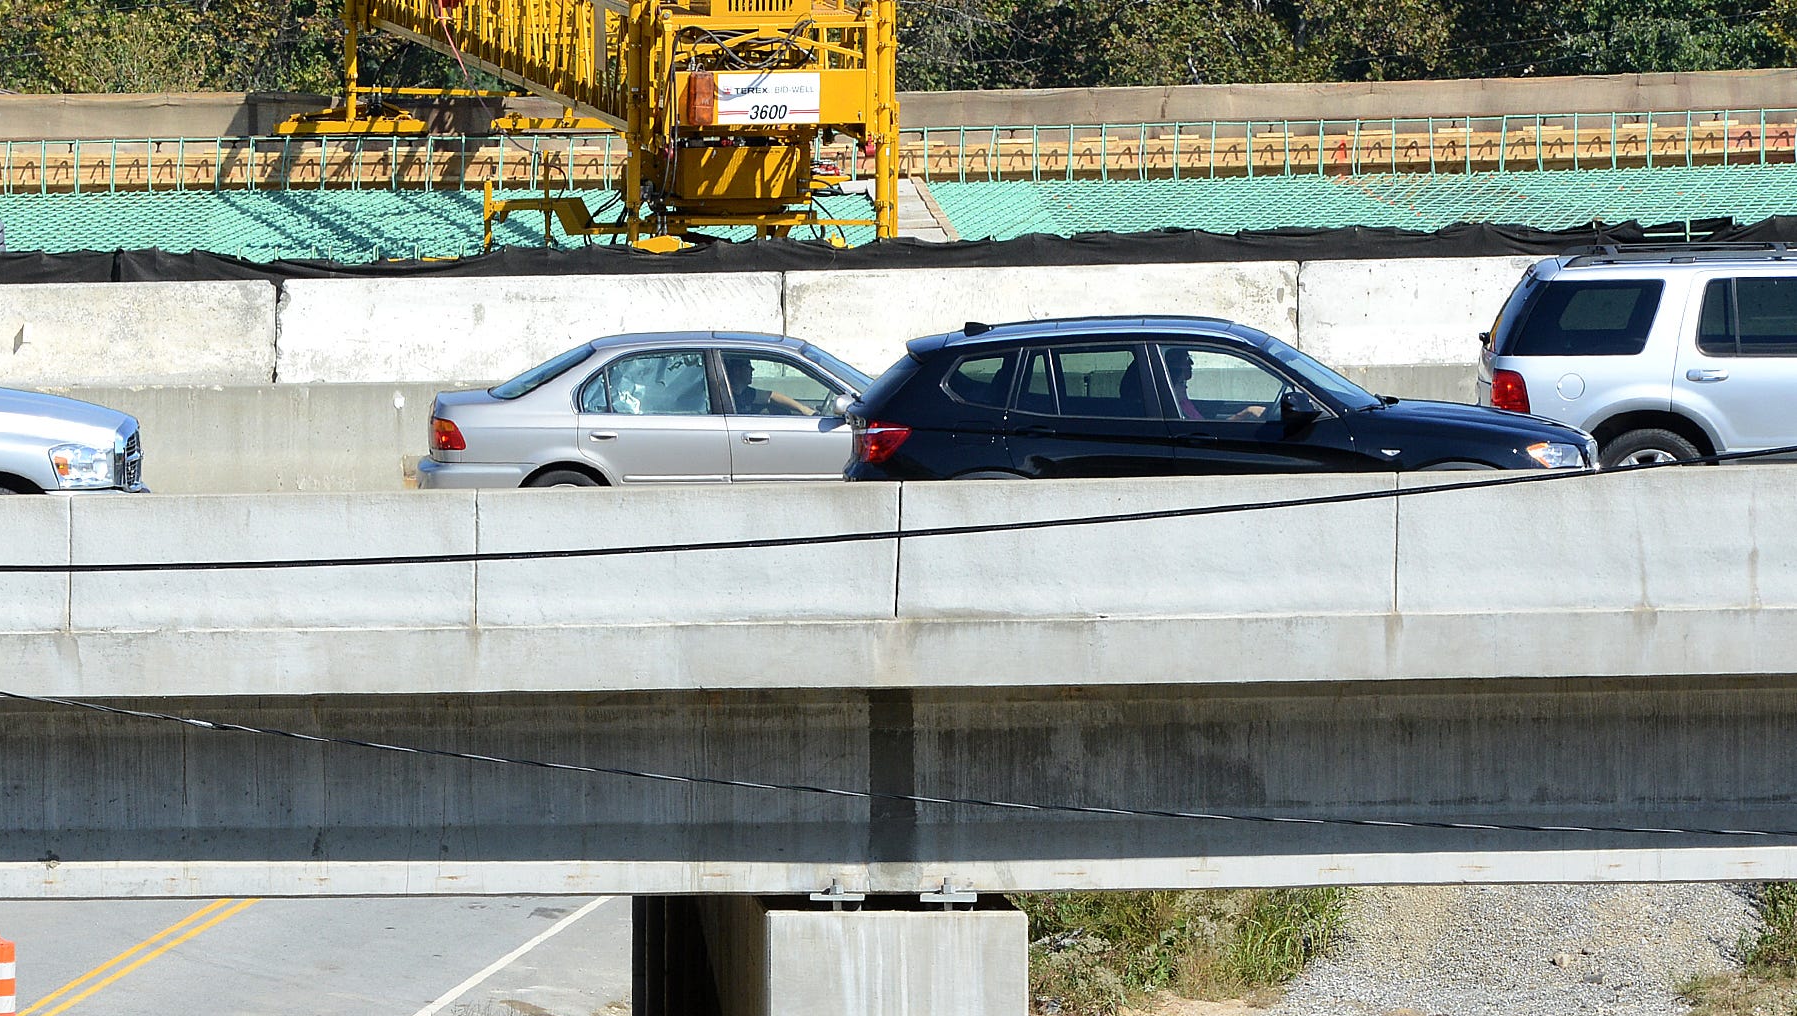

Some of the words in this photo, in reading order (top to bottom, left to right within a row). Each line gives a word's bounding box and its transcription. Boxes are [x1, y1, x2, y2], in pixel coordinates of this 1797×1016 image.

[734, 87, 768, 95] TEREX
[774, 86, 814, 94] BID-WELL
[749, 104, 788, 120] 3600
